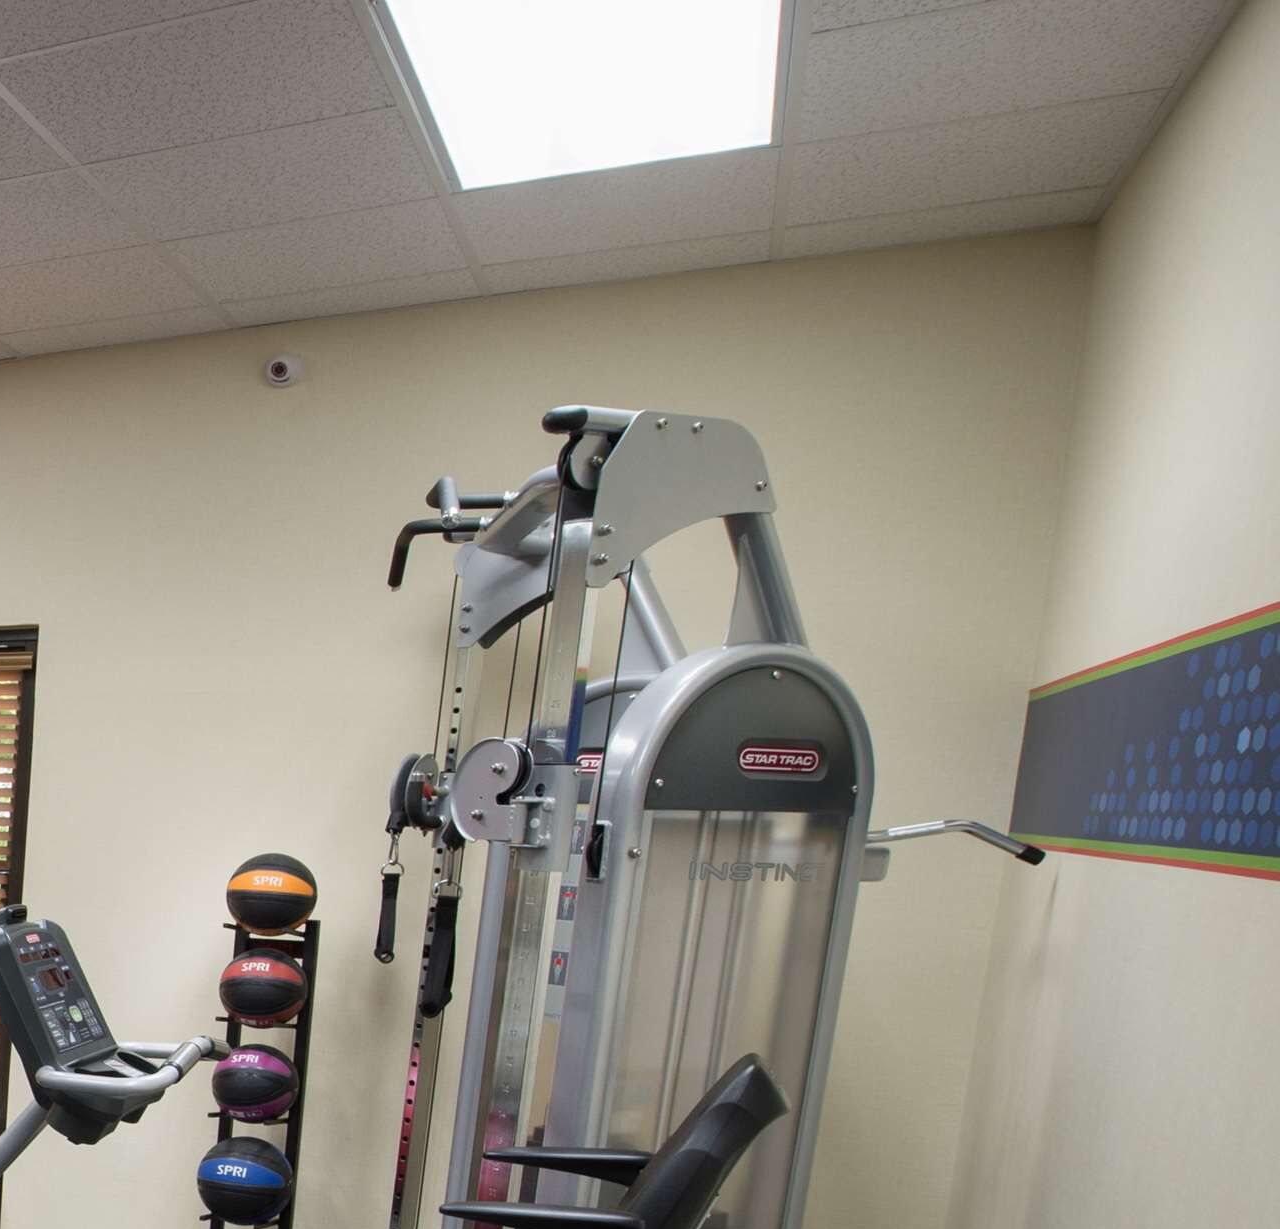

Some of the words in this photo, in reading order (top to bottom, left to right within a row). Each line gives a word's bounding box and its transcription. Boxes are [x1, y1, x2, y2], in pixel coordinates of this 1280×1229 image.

[579, 759, 603, 769] STA
[743, 753, 779, 765] STAR
[778, 755, 815, 766] TRAC
[252, 875, 284, 887] SPRI
[241, 962, 271, 972] SPRI
[230, 1055, 260, 1064] SPRI
[216, 1164, 248, 1178] SPRI
